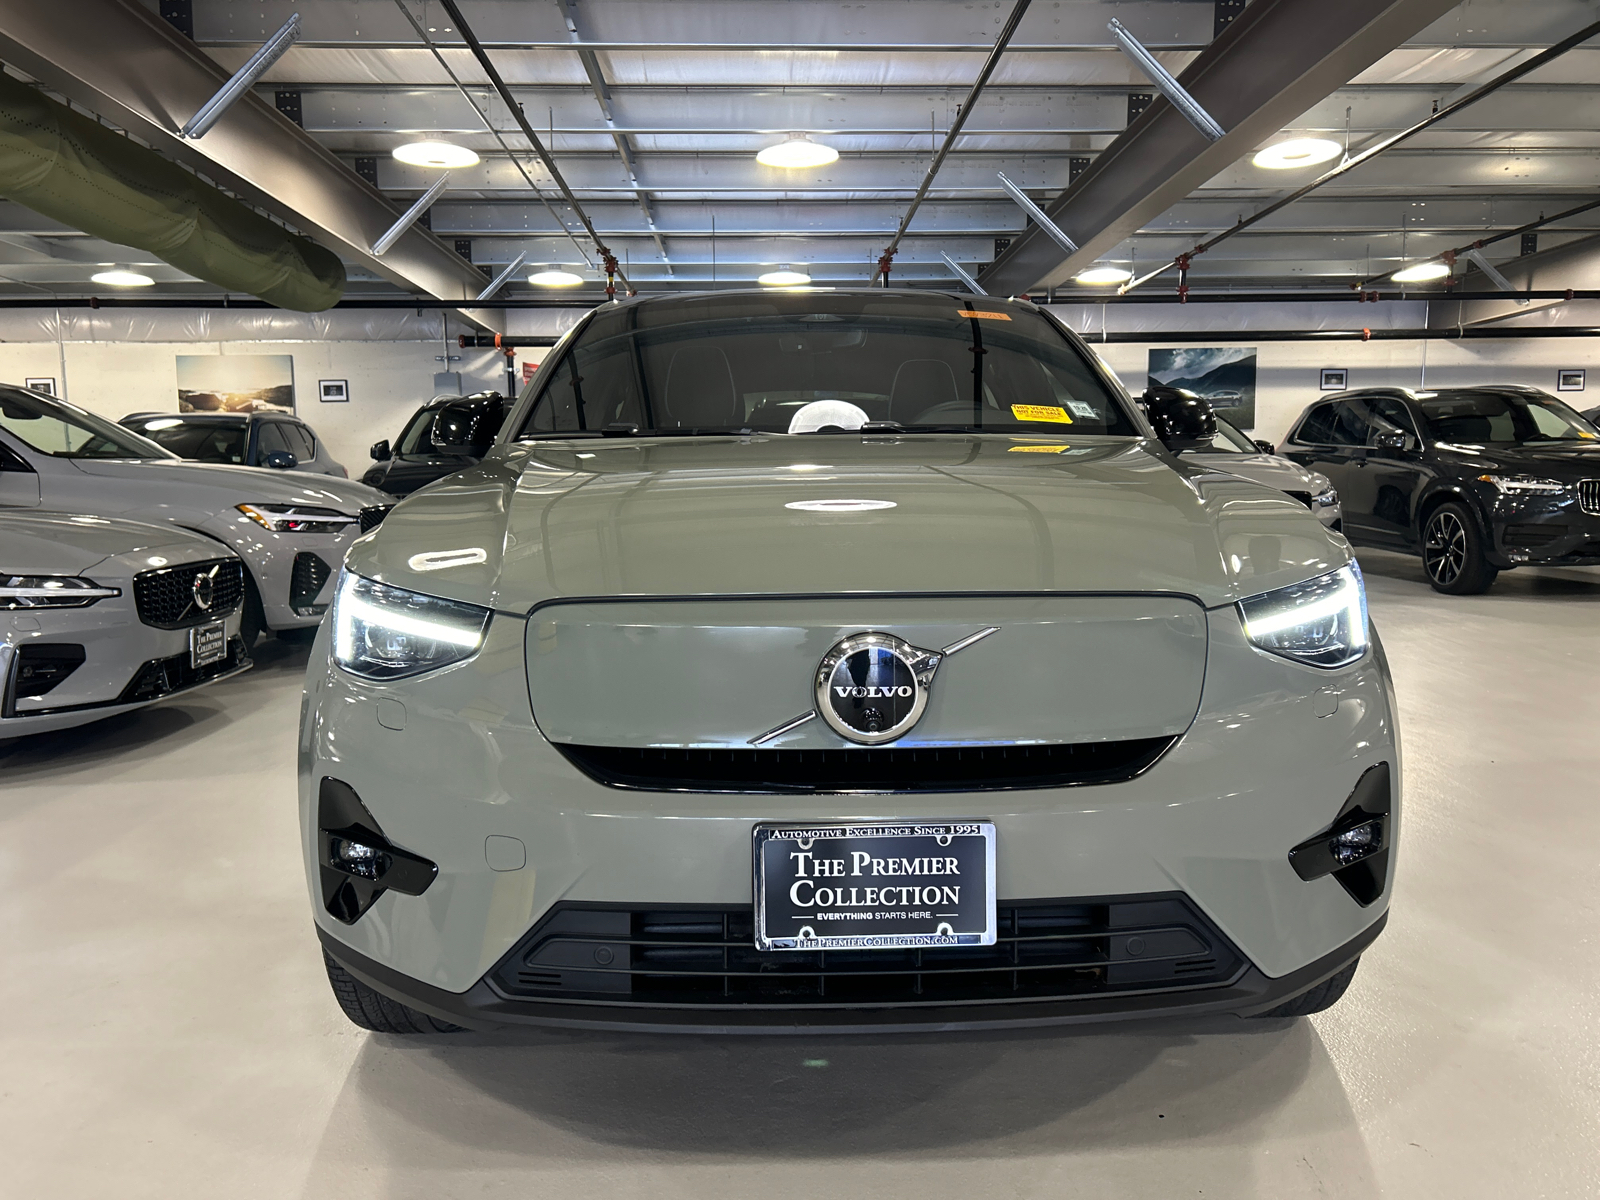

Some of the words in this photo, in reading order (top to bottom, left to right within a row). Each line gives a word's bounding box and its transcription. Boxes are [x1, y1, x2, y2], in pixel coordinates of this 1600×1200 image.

[834, 685, 913, 698] VOLVO
[771, 829, 843, 839] AUTOMOTIVE
[845, 827, 911, 837] EXCELLENCE
[914, 826, 946, 835] SINCE
[949, 825, 979, 834] 1995
[789, 851, 846, 878] THE
[850, 851, 961, 877] PREMIER
[789, 879, 961, 908] COLLECTION
[817, 912, 873, 921] EVERYTHING
[875, 911, 907, 920] STARTS
[908, 911, 933, 919] HERE.
